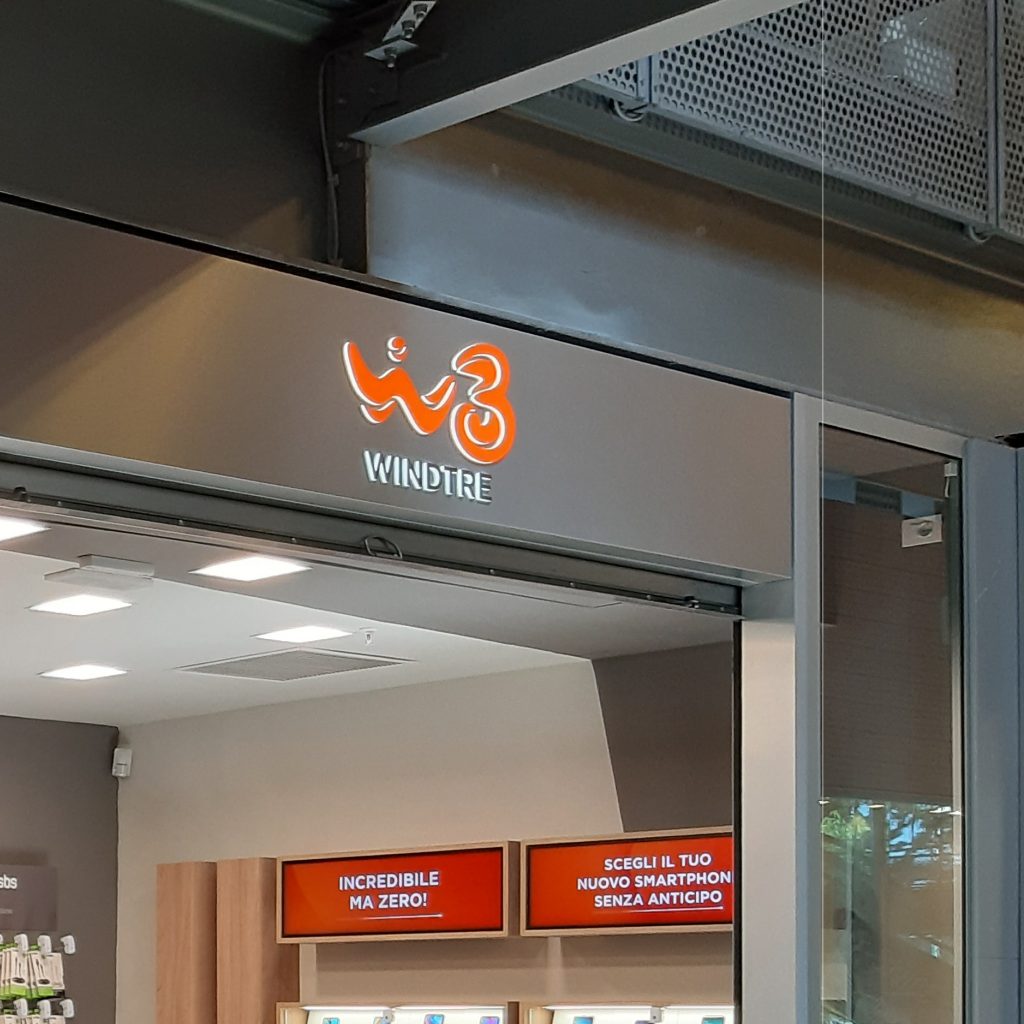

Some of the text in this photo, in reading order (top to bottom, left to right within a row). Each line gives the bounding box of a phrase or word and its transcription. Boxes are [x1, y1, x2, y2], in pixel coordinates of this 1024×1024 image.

[363, 450, 493, 504] WINDTRE
[604, 853, 712, 871] SCEGLI IL TUO
[339, 871, 440, 891] INCREDIBILE
[577, 871, 733, 890] NUOVO SMARTPHON
[349, 893, 427, 910] MA ZERO!
[594, 890, 722, 907] SENZA ANTICIPO
